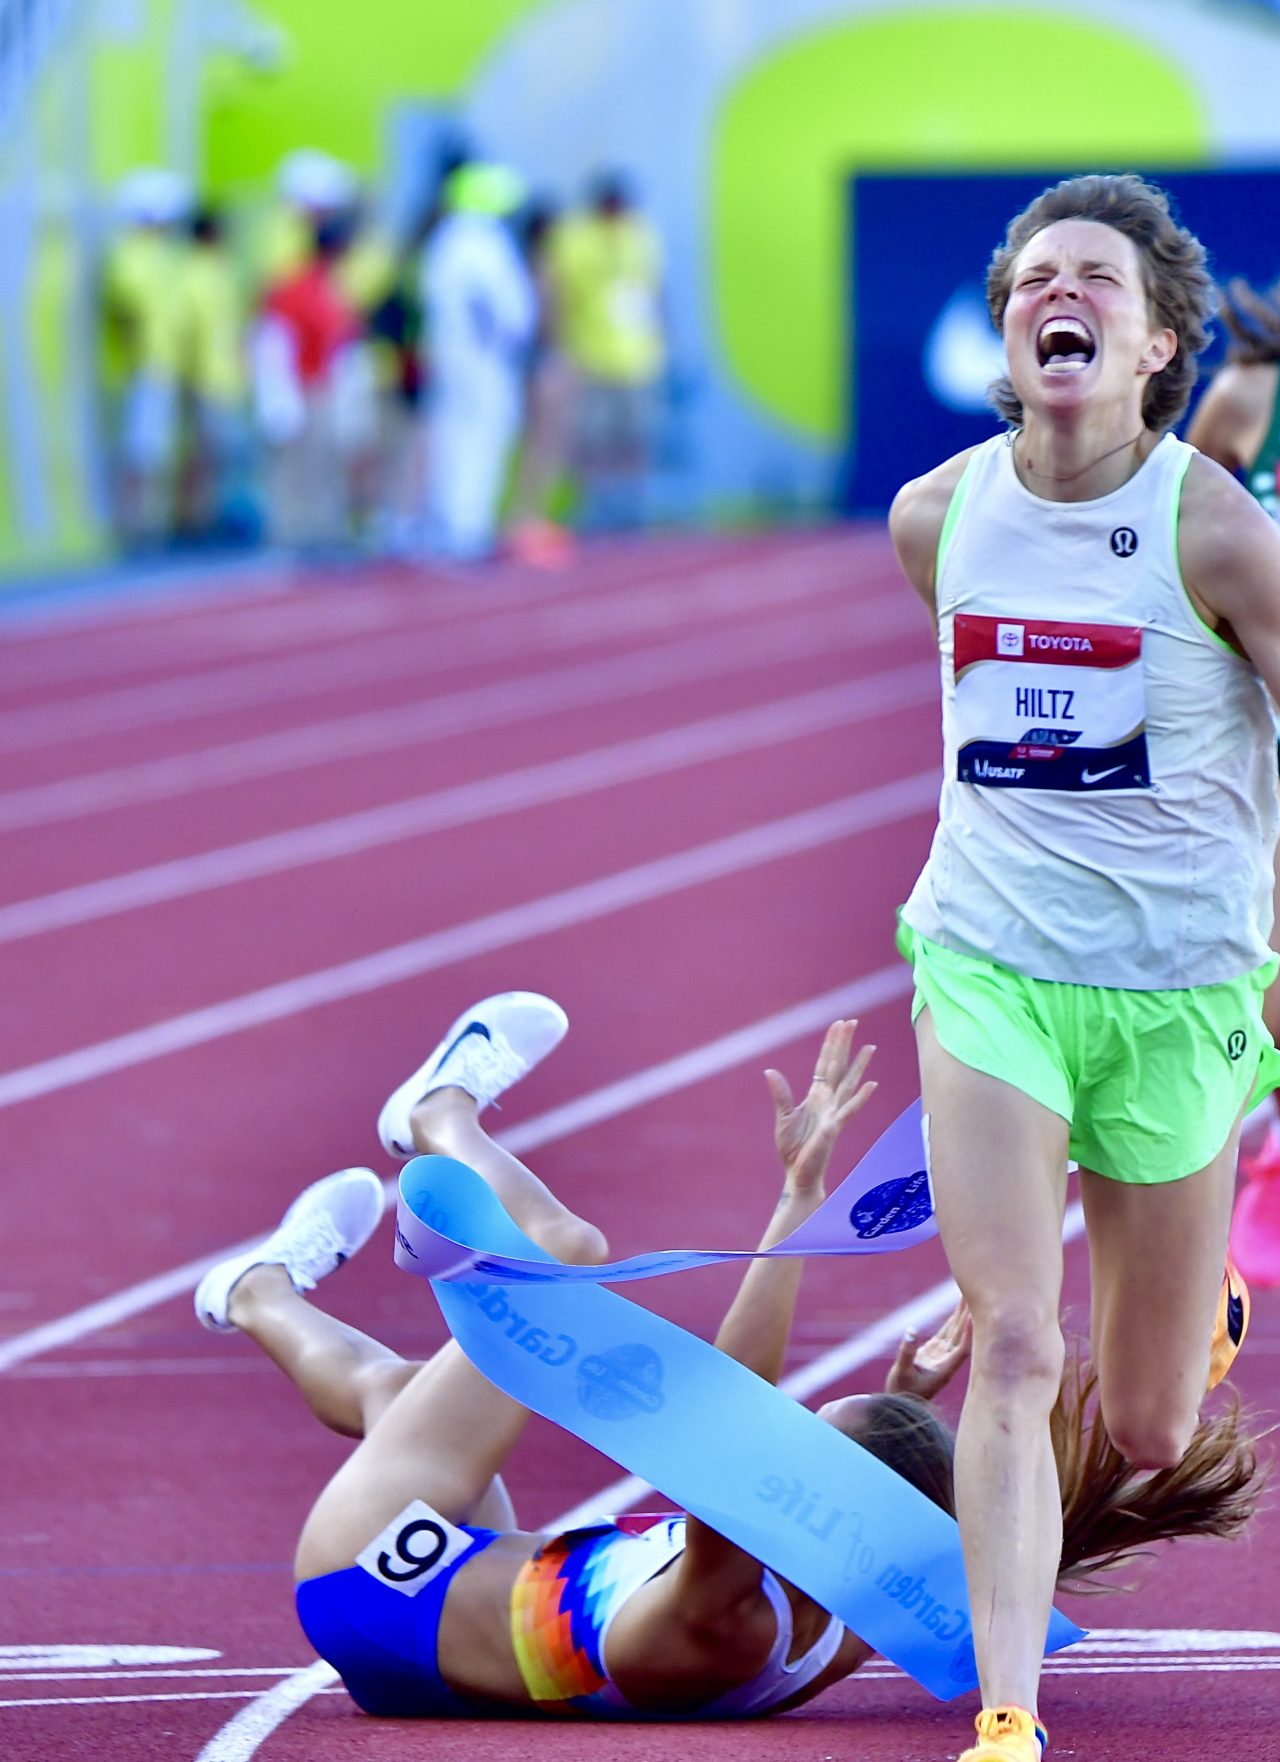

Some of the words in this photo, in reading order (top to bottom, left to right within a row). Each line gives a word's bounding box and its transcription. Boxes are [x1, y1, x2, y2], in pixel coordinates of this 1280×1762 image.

[1028, 634, 1094, 652] TOYOTA
[1016, 687, 1075, 720] HILTZ
[988, 766, 1026, 780] USATF
[377, 1519, 448, 1582] 9
